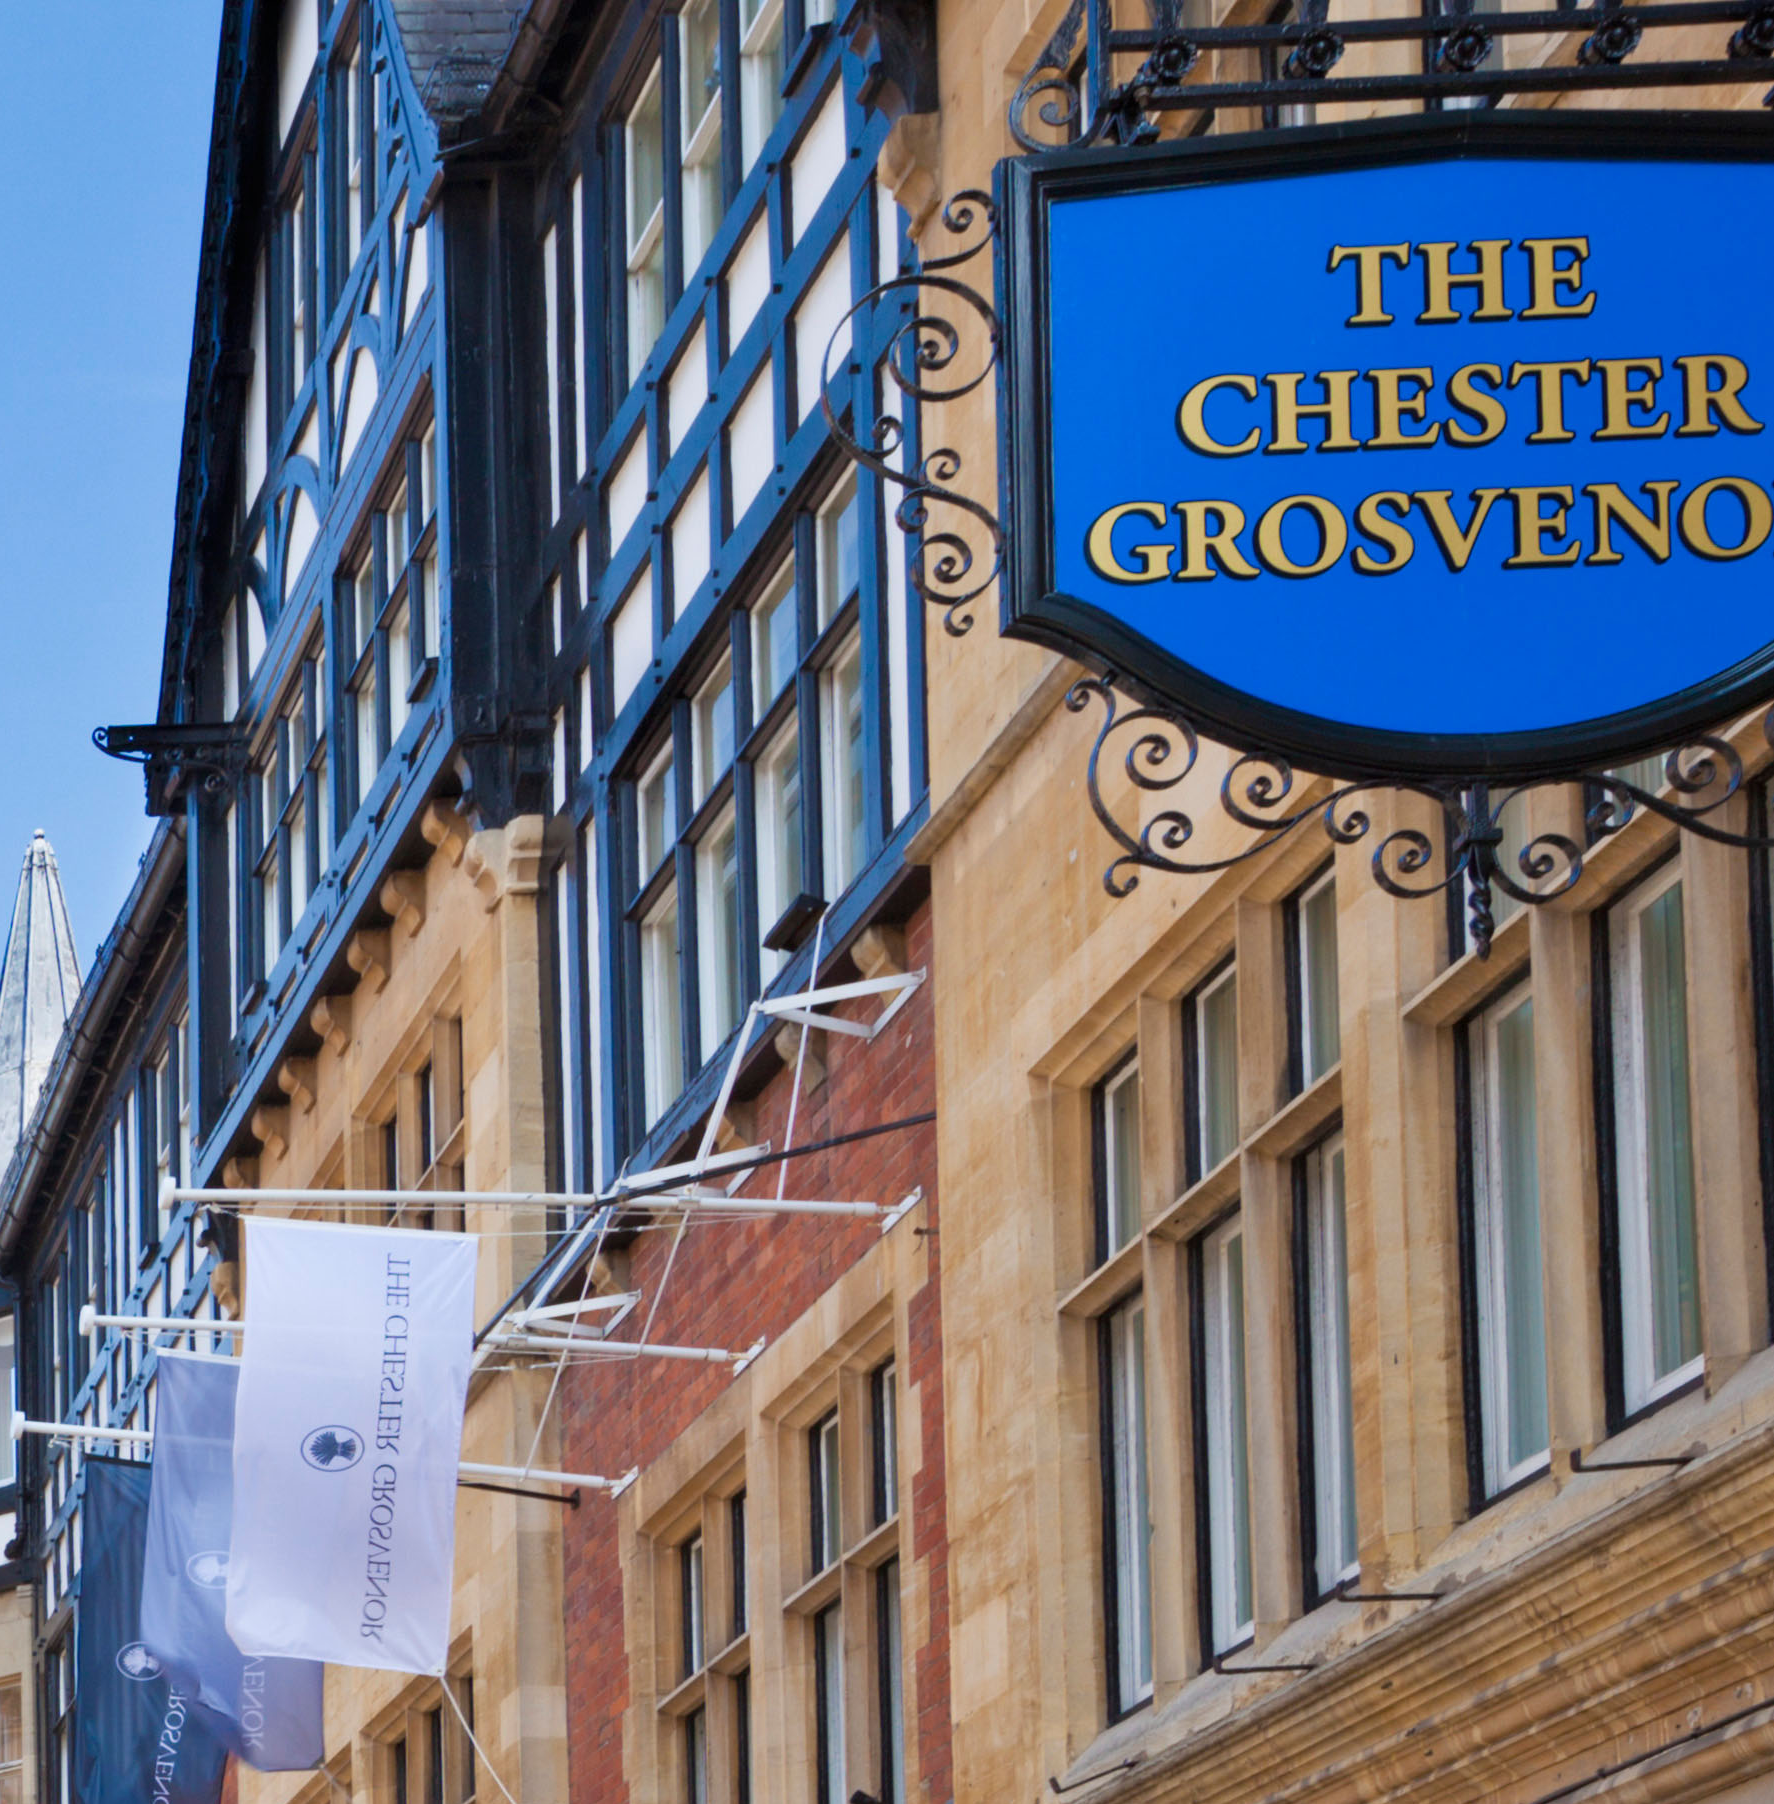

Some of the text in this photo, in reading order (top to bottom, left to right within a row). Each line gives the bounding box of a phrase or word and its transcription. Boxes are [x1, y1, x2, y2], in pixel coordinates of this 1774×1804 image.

[1326, 234, 1597, 328] THE
[1175, 353, 1765, 459] CHESTER
[1085, 475, 1774, 587] GROSVENO
